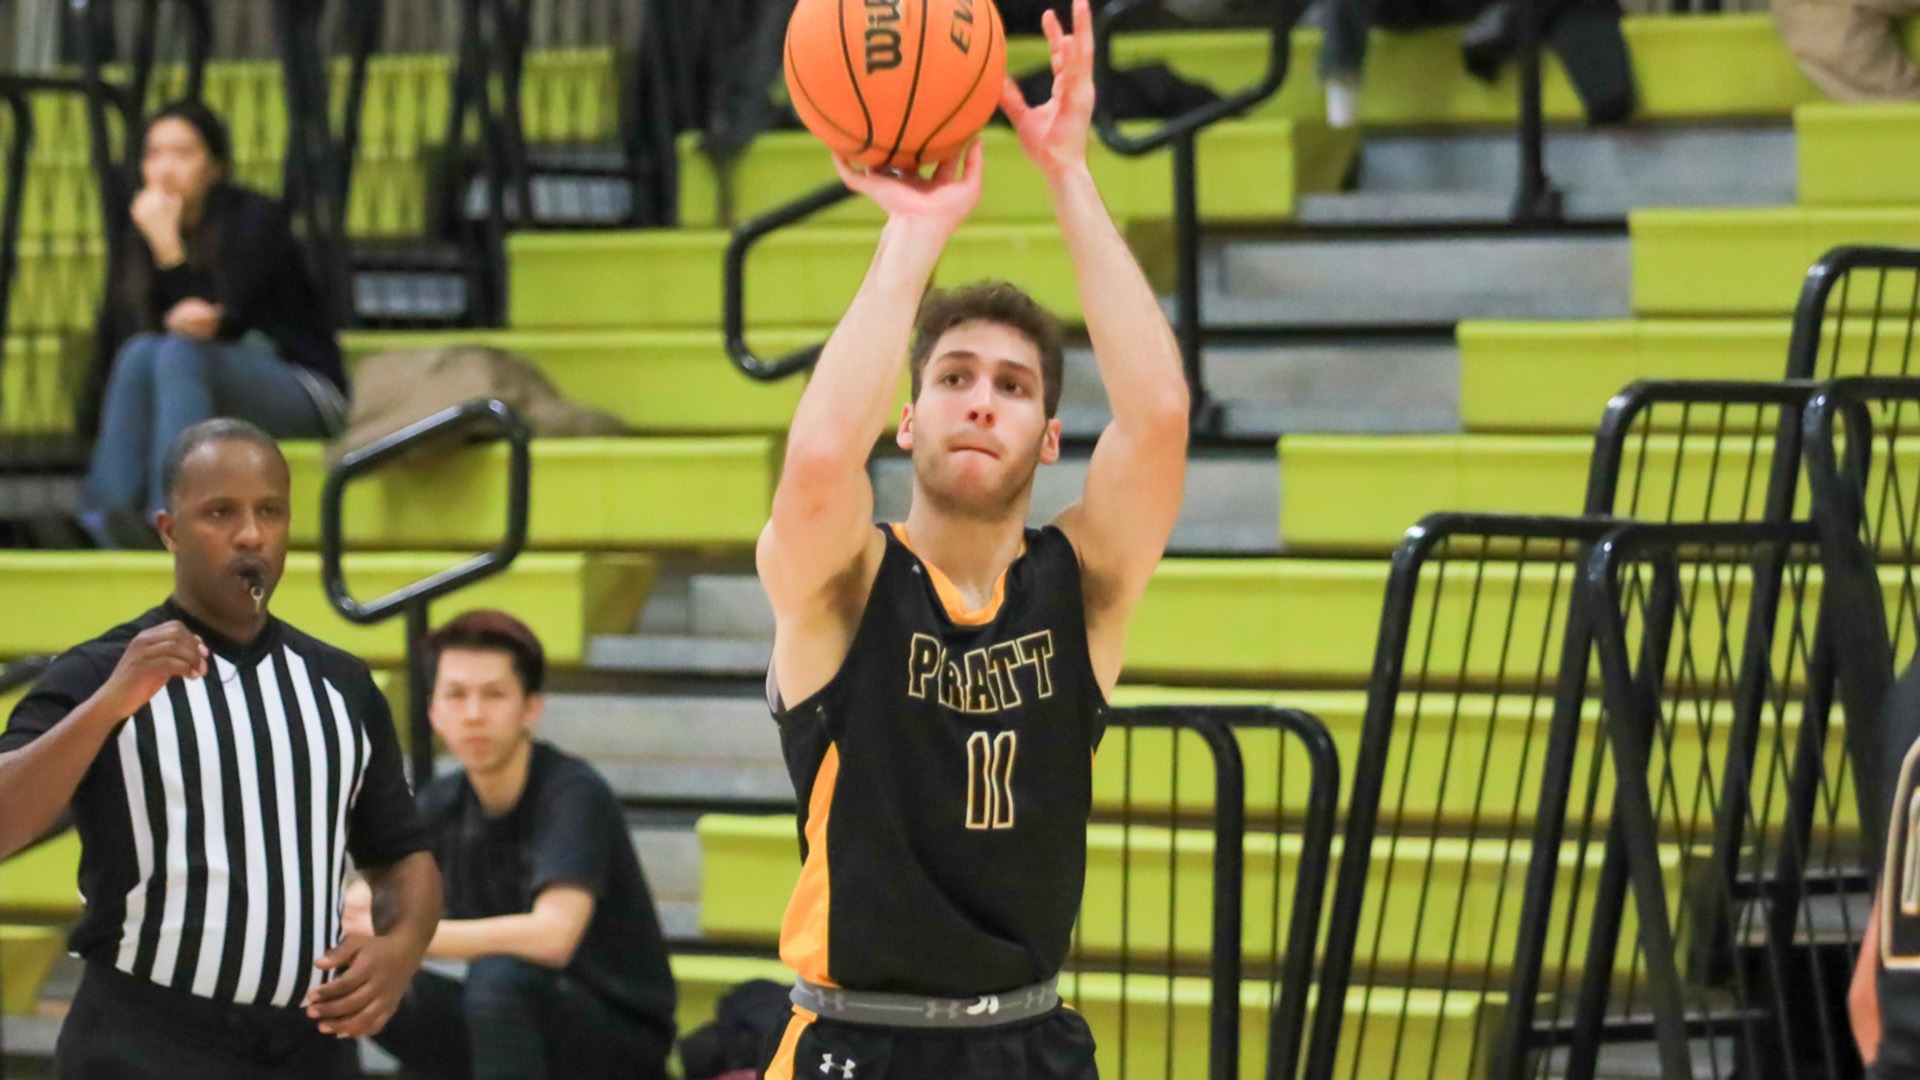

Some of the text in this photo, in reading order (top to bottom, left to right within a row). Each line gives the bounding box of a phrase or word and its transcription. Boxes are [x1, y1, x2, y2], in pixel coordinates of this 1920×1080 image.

[950, 0, 975, 55] EV
[908, 629, 1053, 713] PRATT
[965, 730, 1017, 829] 11
